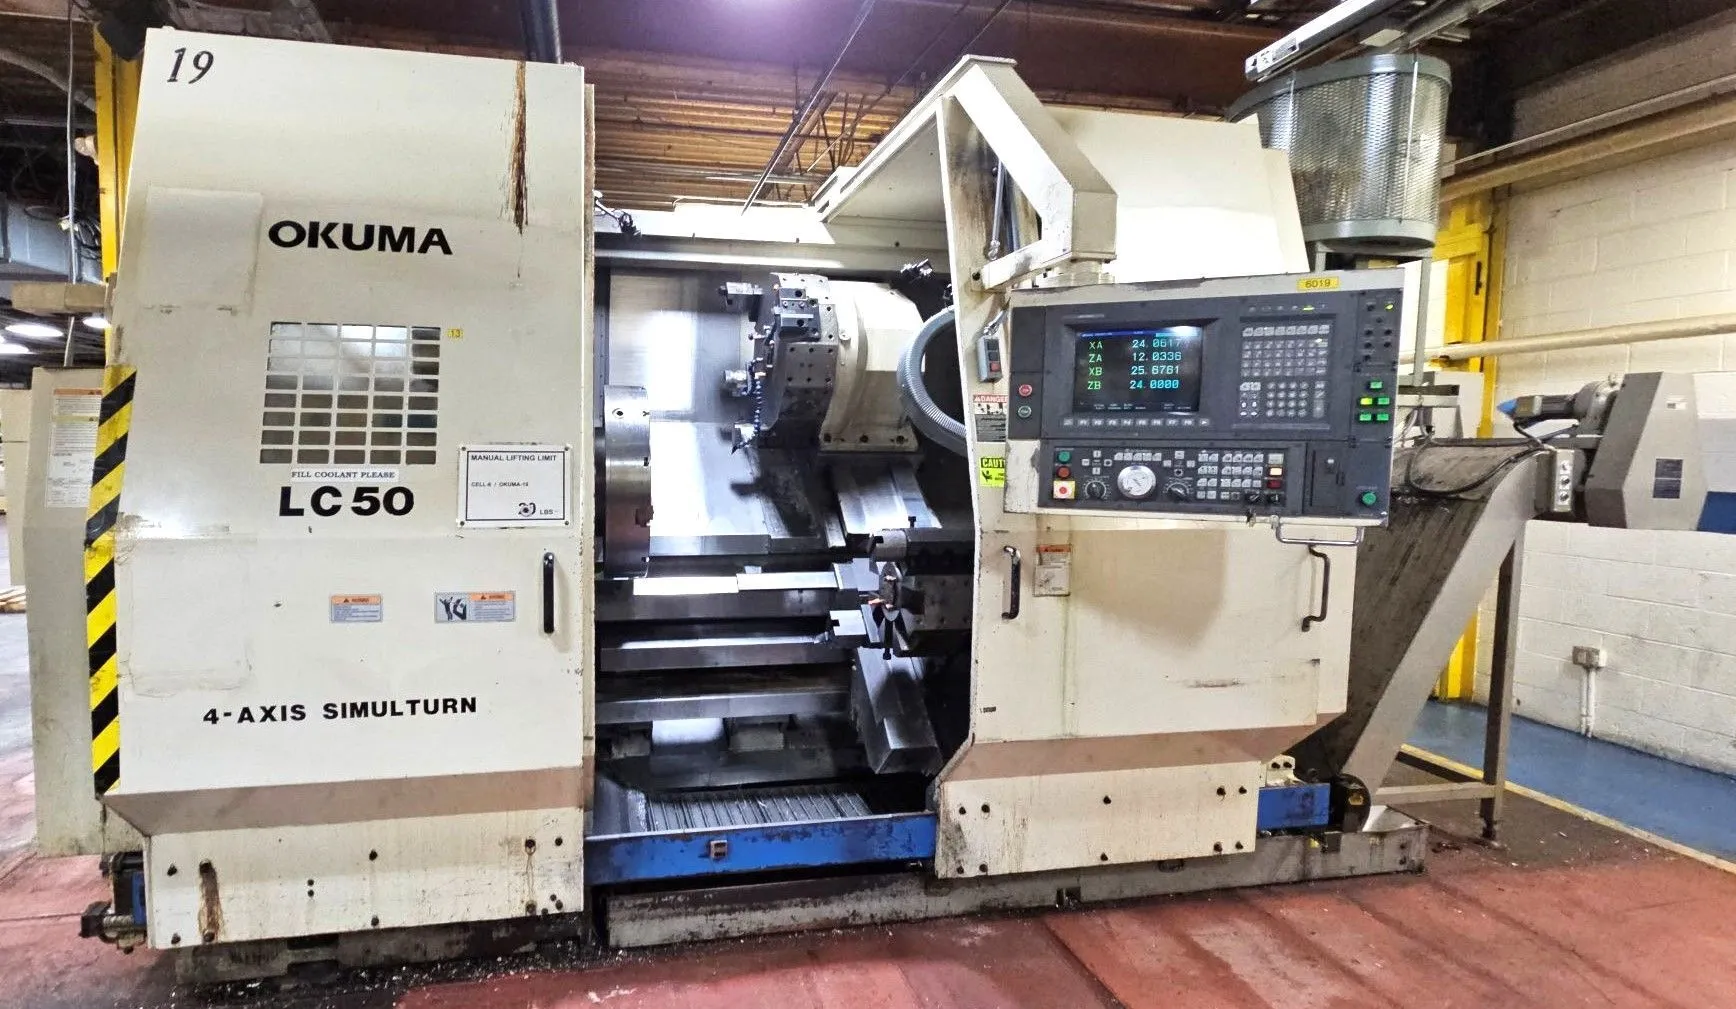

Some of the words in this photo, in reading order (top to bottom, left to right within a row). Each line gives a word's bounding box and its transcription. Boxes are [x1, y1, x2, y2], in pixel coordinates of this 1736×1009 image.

[167, 47, 214, 84] 19
[268, 220, 453, 255] OKUMA
[1305, 278, 1331, 288] 6019
[1089, 341, 1103, 349] XA
[1088, 353, 1102, 362] ZA
[1132, 351, 1182, 361] 12.0336
[1088, 366, 1103, 376] XB
[1087, 380, 1101, 390] ZB
[1129, 379, 1179, 389] 24.0000
[982, 458, 1004, 468] CAUT
[203, 703, 307, 725] 4-AXIS
[322, 696, 477, 720] SIMULTURN
